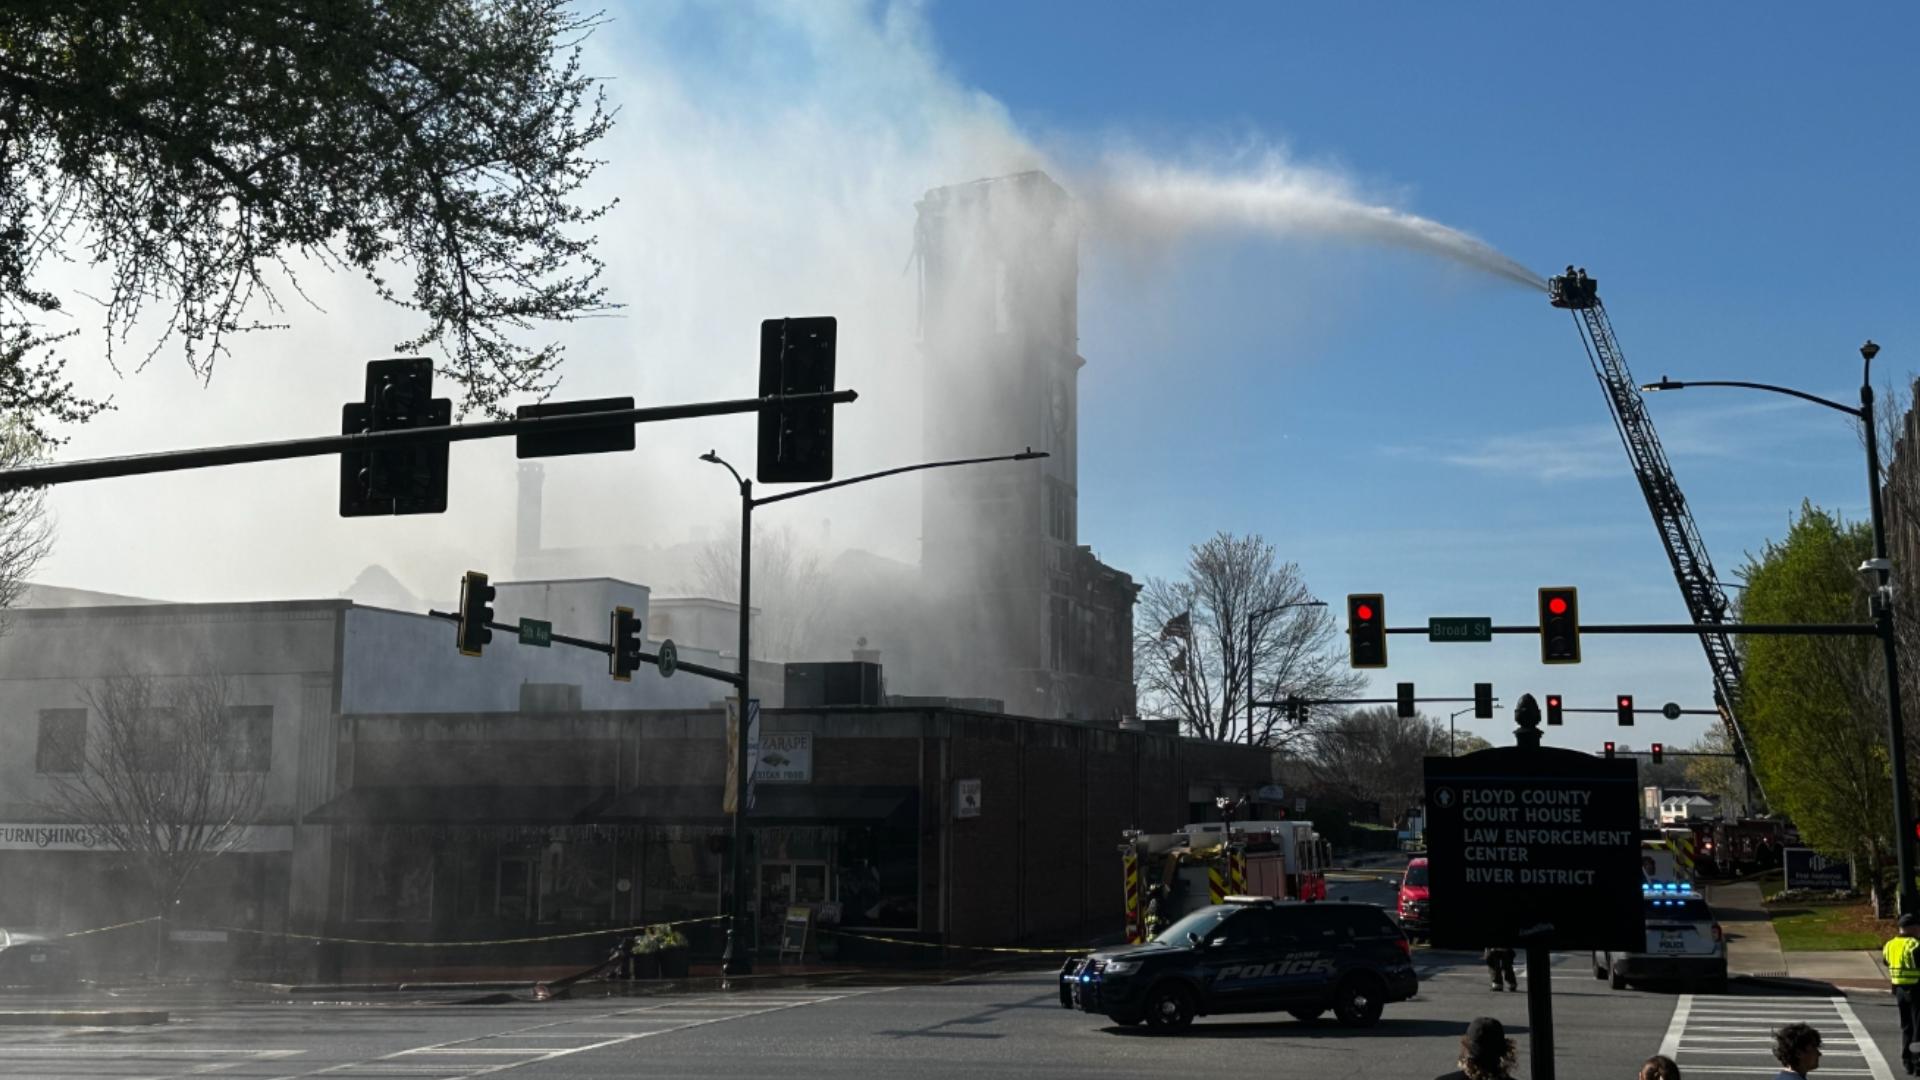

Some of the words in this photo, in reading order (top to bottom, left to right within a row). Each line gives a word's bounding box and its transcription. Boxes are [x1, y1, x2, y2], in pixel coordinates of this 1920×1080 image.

[1433, 623, 1468, 636] Broad
[1473, 623, 1487, 636] St
[1462, 789, 1516, 804] FLOYD
[1521, 789, 1592, 805] COUNTY
[1462, 807, 1519, 823] COURT
[1525, 808, 1582, 823] HOUSE
[1463, 828, 1499, 843] LAW
[1505, 829, 1632, 846] ENFORCEMENT
[1464, 846, 1529, 862] CENTER
[1465, 867, 1515, 884] RIVER
[1520, 868, 1596, 885] DISTRICT
[1659, 942, 1685, 950] POLICE
[1215, 958, 1335, 981] POLICE
